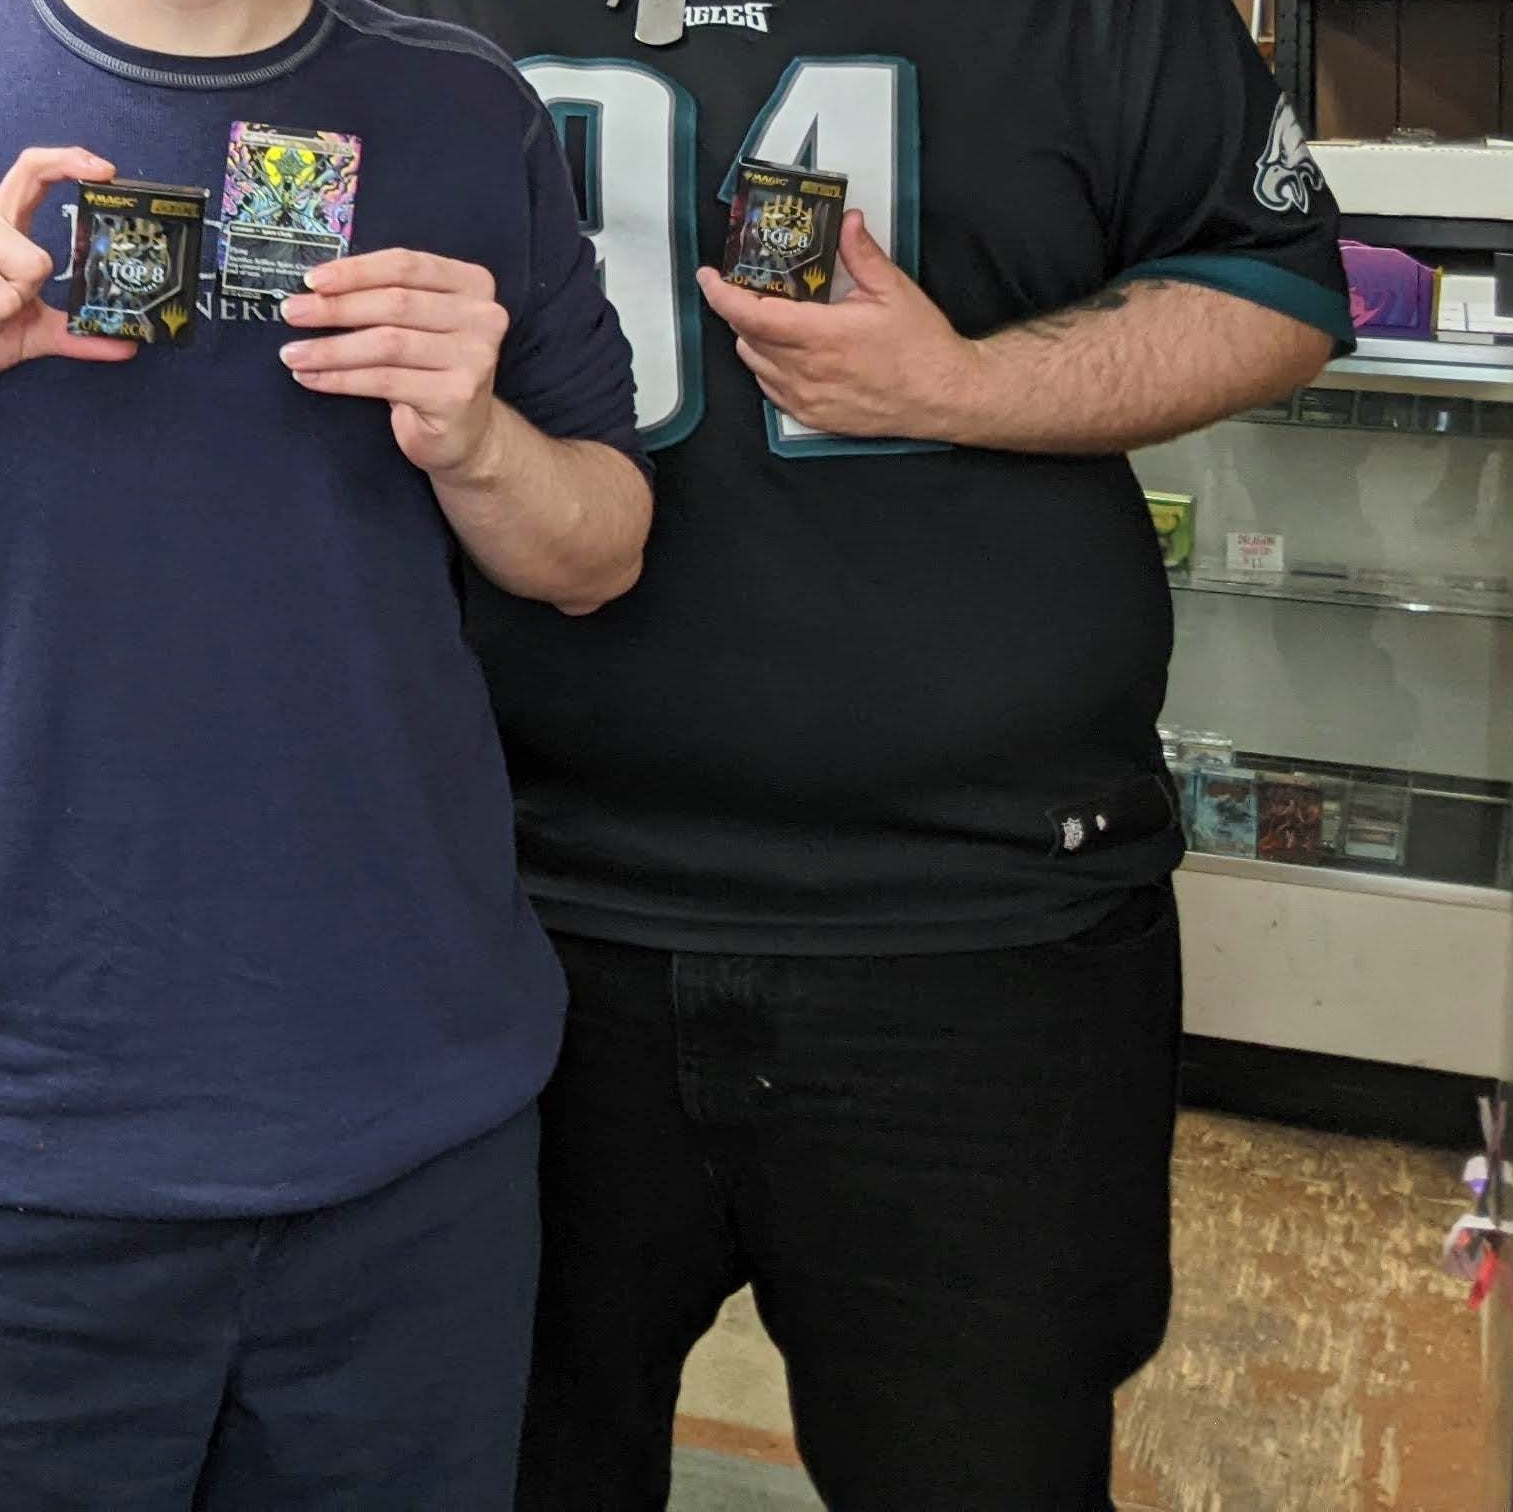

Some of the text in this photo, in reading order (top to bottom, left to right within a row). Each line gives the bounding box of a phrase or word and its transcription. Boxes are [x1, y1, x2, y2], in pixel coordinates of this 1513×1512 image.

[684, 3, 773, 33] AGLES
[752, 174, 789, 186] MAGIC
[95, 194, 138, 208] MAGIC
[760, 228, 808, 248] TOP 8
[109, 261, 165, 286] TOP 8
[196, 292, 281, 322] NER
